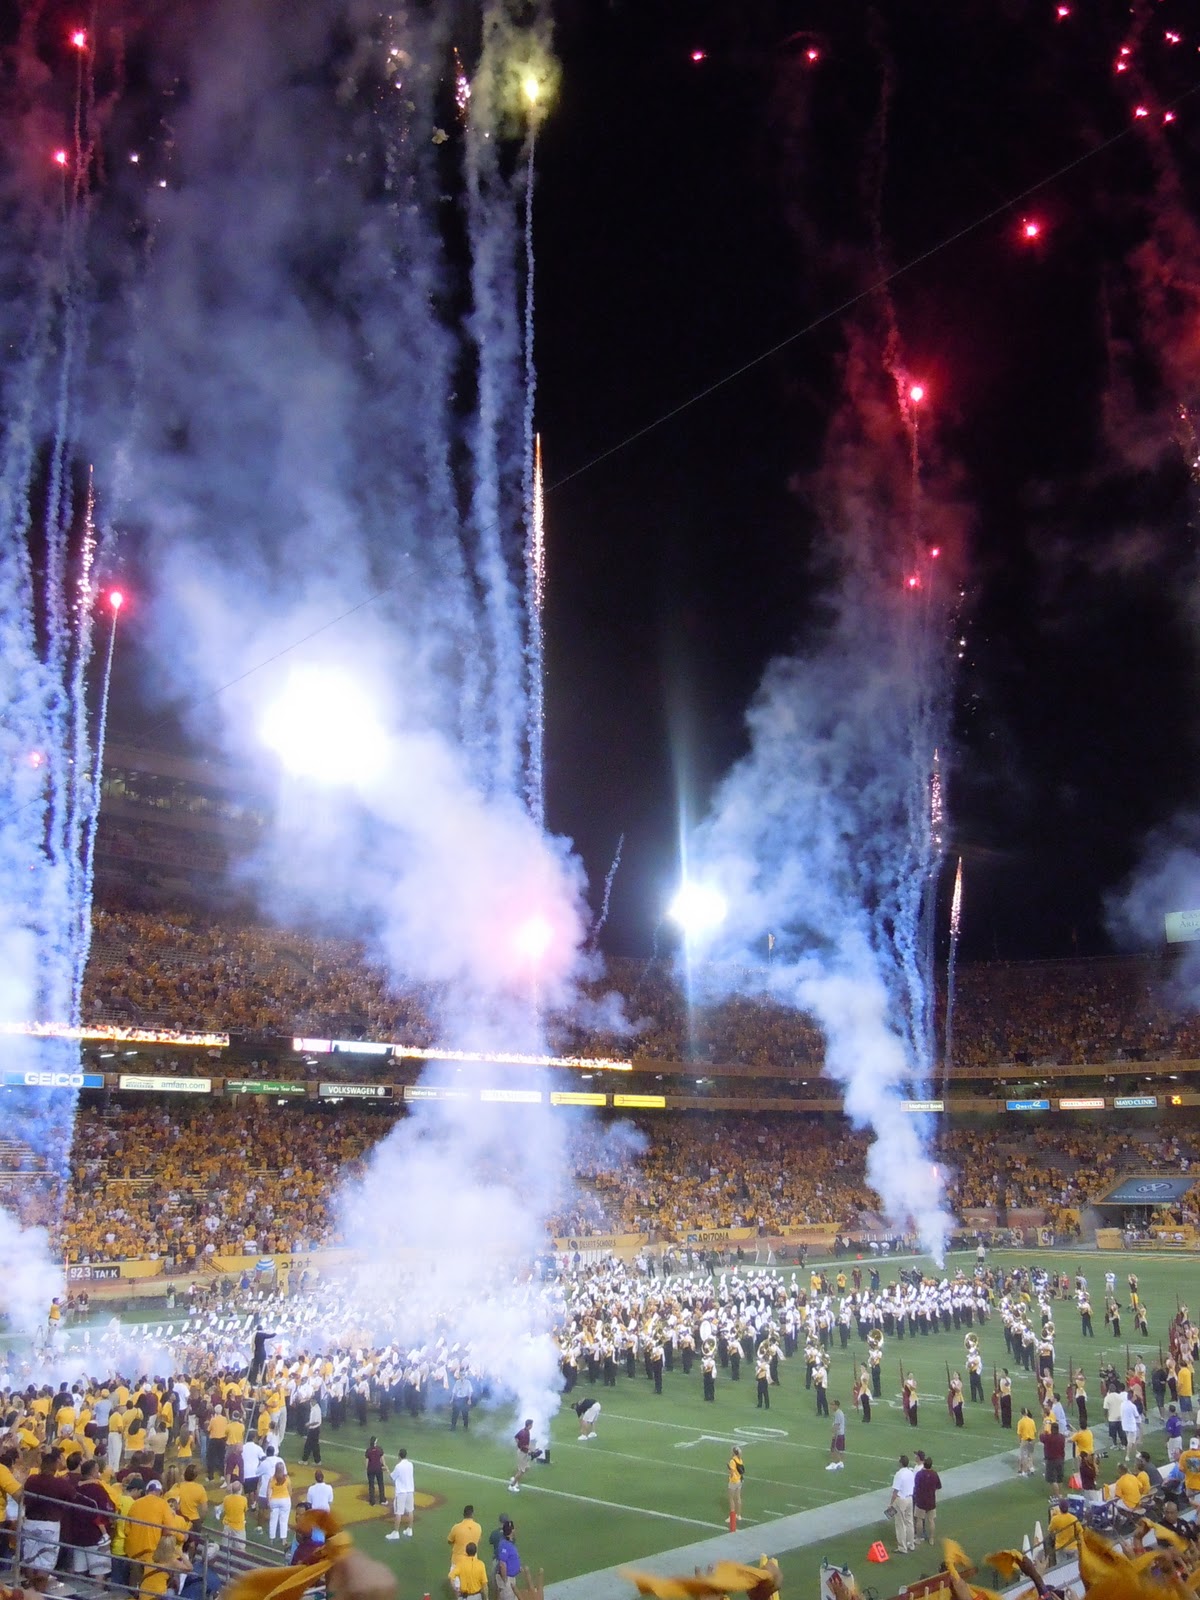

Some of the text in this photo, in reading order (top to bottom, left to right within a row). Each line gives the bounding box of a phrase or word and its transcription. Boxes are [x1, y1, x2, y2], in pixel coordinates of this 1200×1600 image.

[24, 1072, 85, 1087] GEICO
[161, 1081, 206, 1090] amfam.com
[328, 1086, 376, 1095] VOLKSWAGEN
[698, 1231, 730, 1242] ARIZONA
[94, 1268, 118, 1279] TALK
[875, 1543, 887, 1559] G
